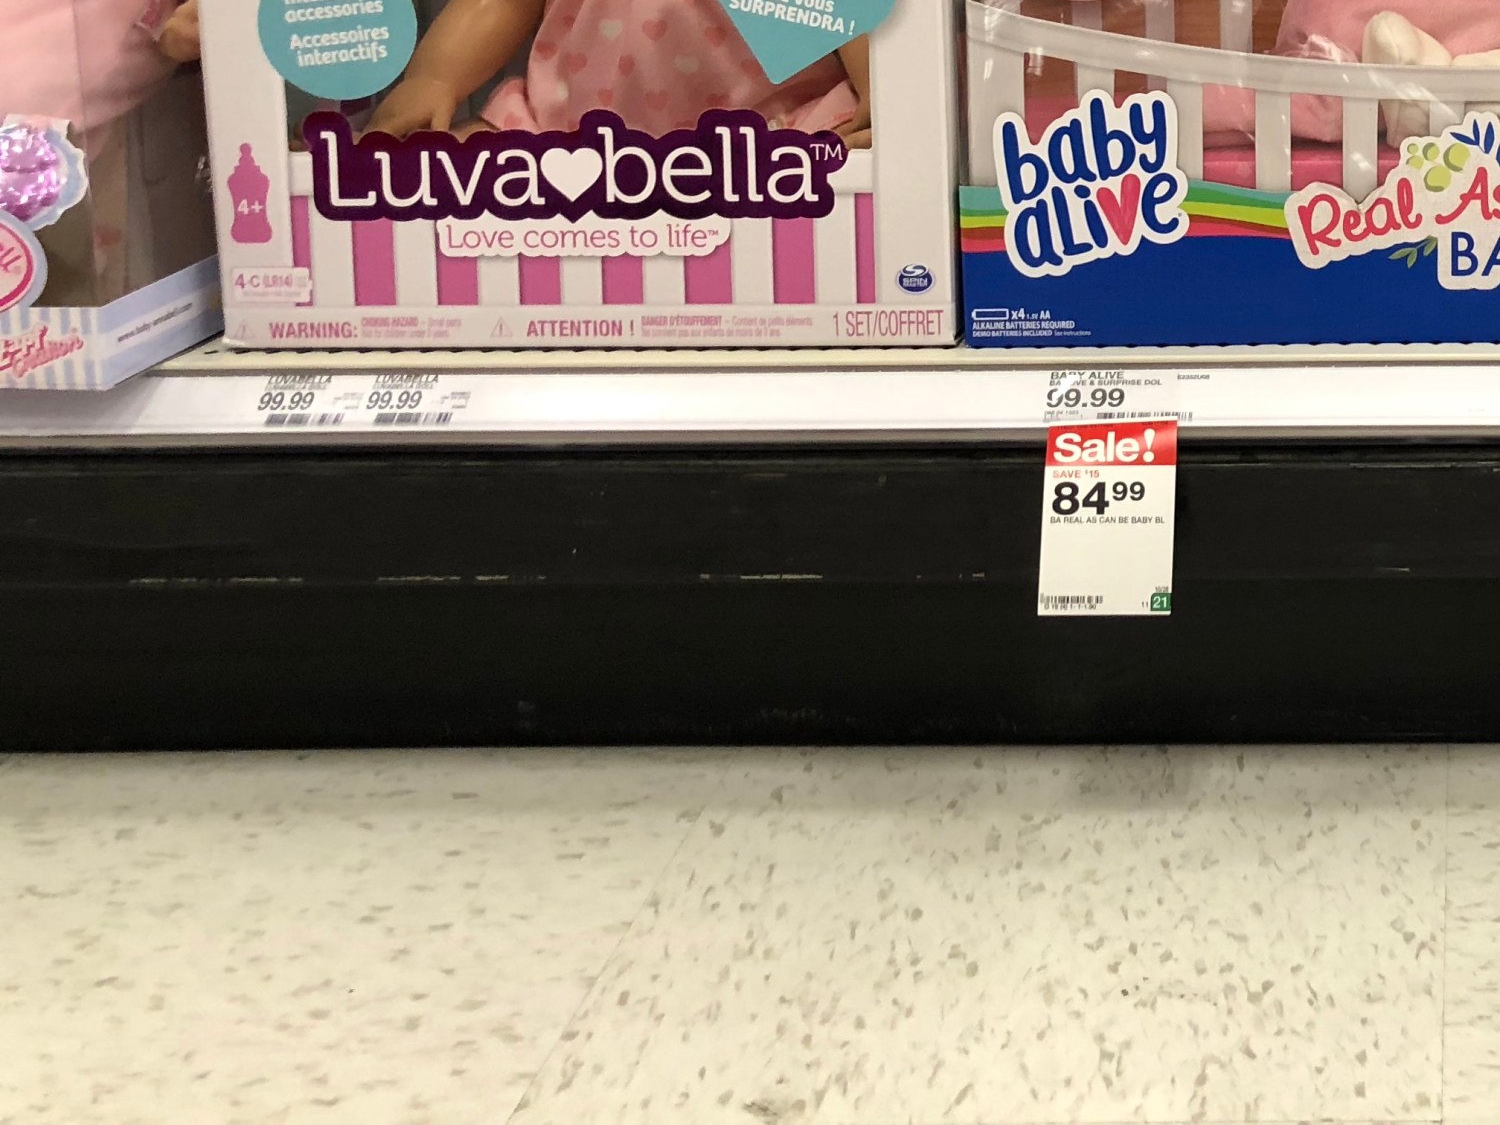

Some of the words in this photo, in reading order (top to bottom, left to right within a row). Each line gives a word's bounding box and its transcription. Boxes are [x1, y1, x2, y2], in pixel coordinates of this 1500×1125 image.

[290, 24, 390, 50] Accessoires
[296, 41, 388, 68] interactifs
[1002, 97, 1167, 204] baby
[237, 198, 264, 216] 4+
[1298, 177, 1423, 255] Real
[445, 224, 514, 249] Love
[523, 229, 623, 249] comes
[628, 226, 659, 249] to
[268, 321, 359, 340] WARNING:
[526, 319, 623, 338] ATTENTION
[832, 313, 840, 337] 1
[845, 309, 944, 337] SET/COFFRET
[972, 321, 1004, 330] ALKALINE
[1005, 321, 1041, 330] BATTERIES
[1041, 320, 1076, 329] REQUIRED
[1088, 371, 1124, 380] ALIVE
[257, 391, 315, 411] 99.99
[366, 390, 423, 410] 99.99
[1053, 427, 1156, 463] Sale!
[1052, 470, 1082, 479] SAVE
[1050, 516, 1061, 524] BA
[1063, 516, 1084, 524] REAL
[1086, 516, 1097, 524] AS
[1099, 516, 1116, 524] CAN
[1118, 516, 1129, 524] BE
[1131, 516, 1153, 524] BABY
[1155, 516, 1166, 524] BL
[1152, 596, 1168, 609] 21
